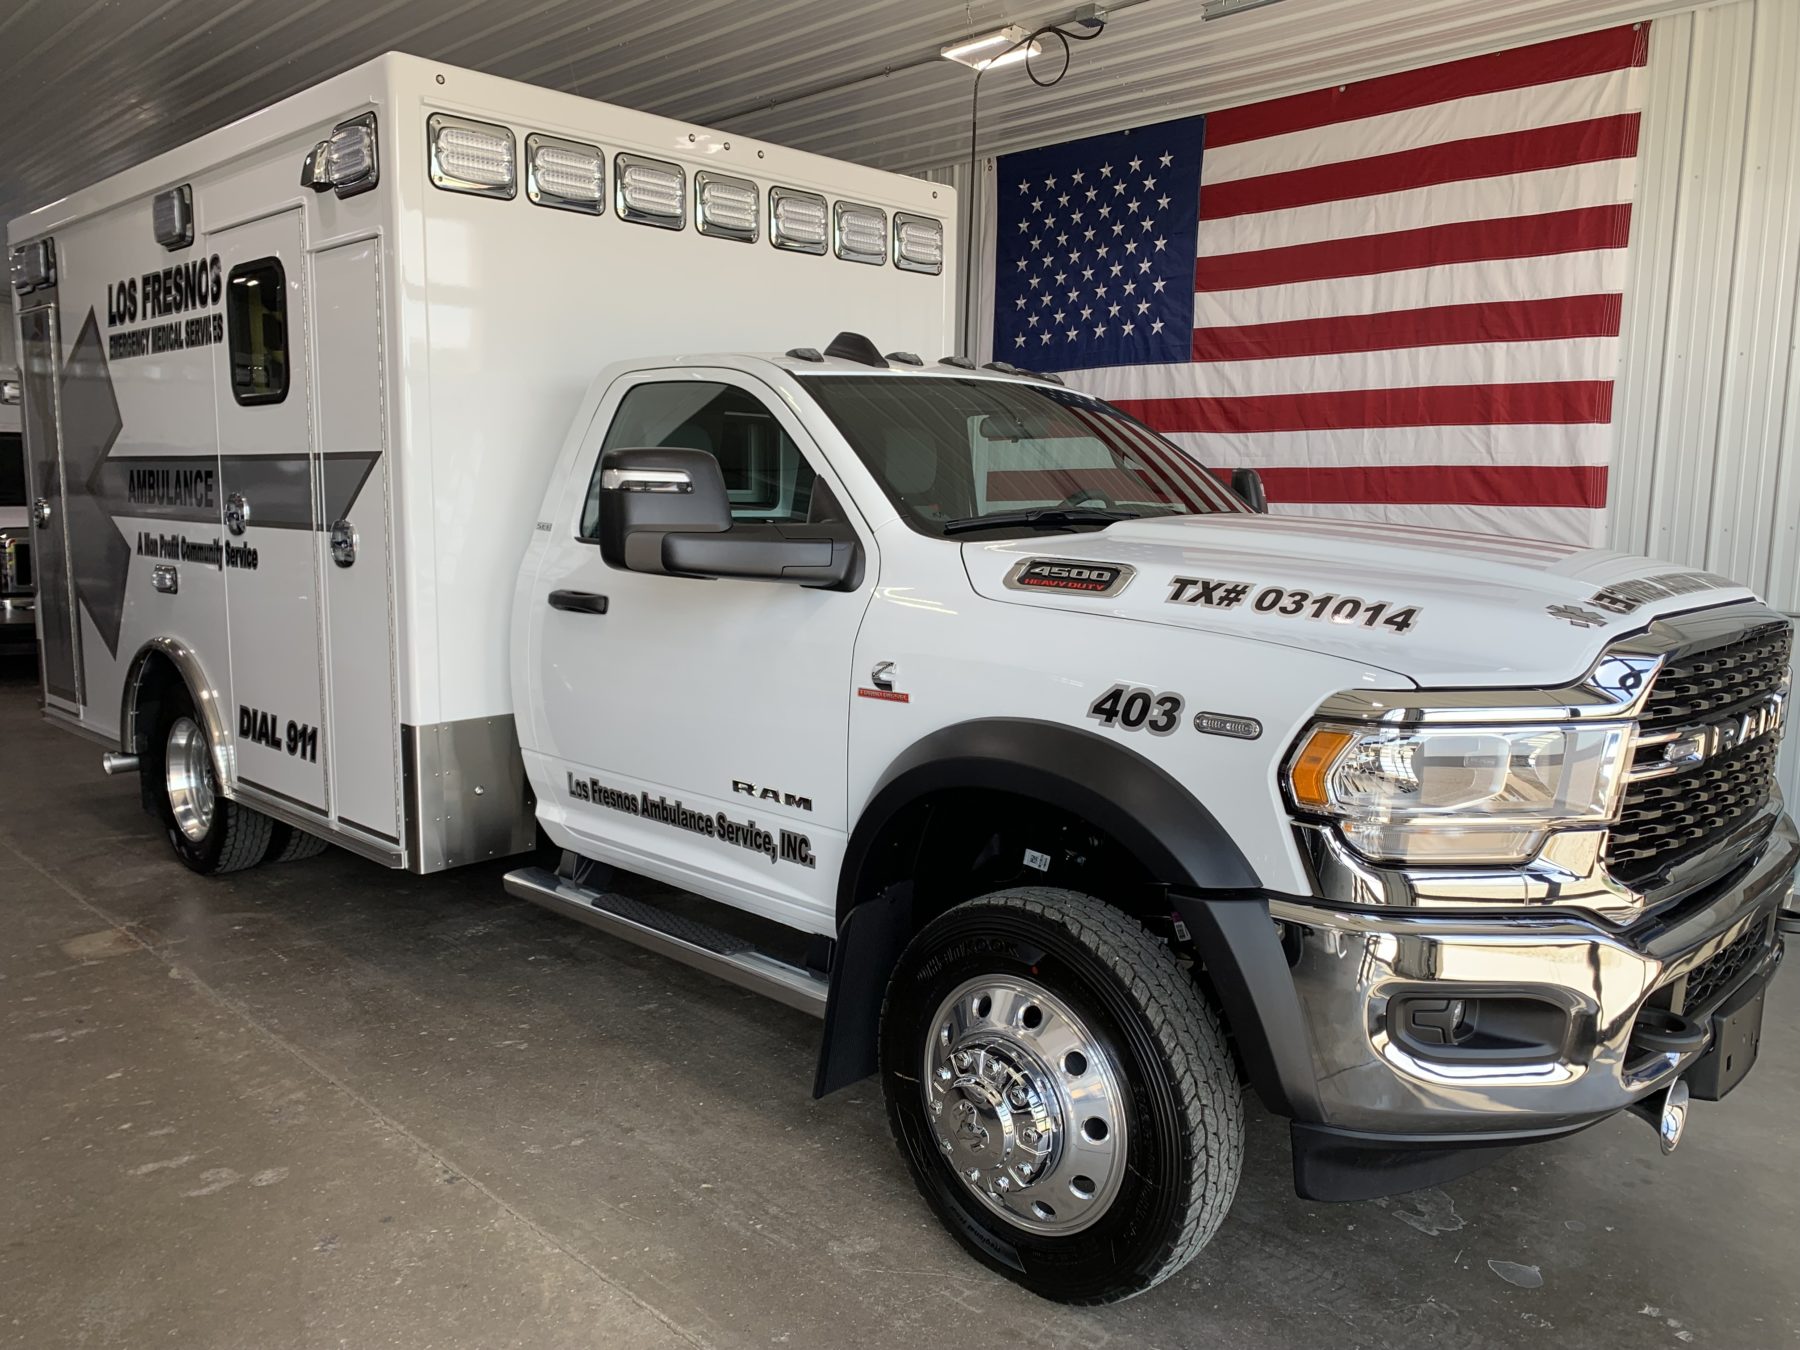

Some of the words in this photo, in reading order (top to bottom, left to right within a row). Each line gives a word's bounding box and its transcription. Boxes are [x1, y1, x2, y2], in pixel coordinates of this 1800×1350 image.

[107, 277, 138, 328] LOS
[141, 253, 222, 320] FRESNOS
[109, 328, 150, 360] EMERGENCY
[150, 321, 184, 355] MEDICAL
[128, 469, 214, 508] AMBULANCE
[137, 532, 144, 556] A
[159, 533, 180, 560] Profit
[180, 536, 223, 571] Community
[224, 540, 258, 570] Service
[1030, 566, 1111, 580] 4500
[1023, 578, 1066, 588] HEAVY
[1067, 581, 1105, 591] DUTY
[1169, 577, 1250, 608] TX#
[1253, 587, 1419, 633] 031014
[1089, 686, 1183, 734] 403
[1710, 690, 1785, 757] RAM
[239, 704, 282, 752] DIAL
[286, 720, 318, 764] 911
[732, 780, 813, 811] RAM
[567, 772, 590, 802] Los
[590, 778, 640, 816] Fresnos
[640, 792, 715, 837] Ambulance
[716, 812, 778, 863] Service,
[779, 829, 816, 869] INC.
